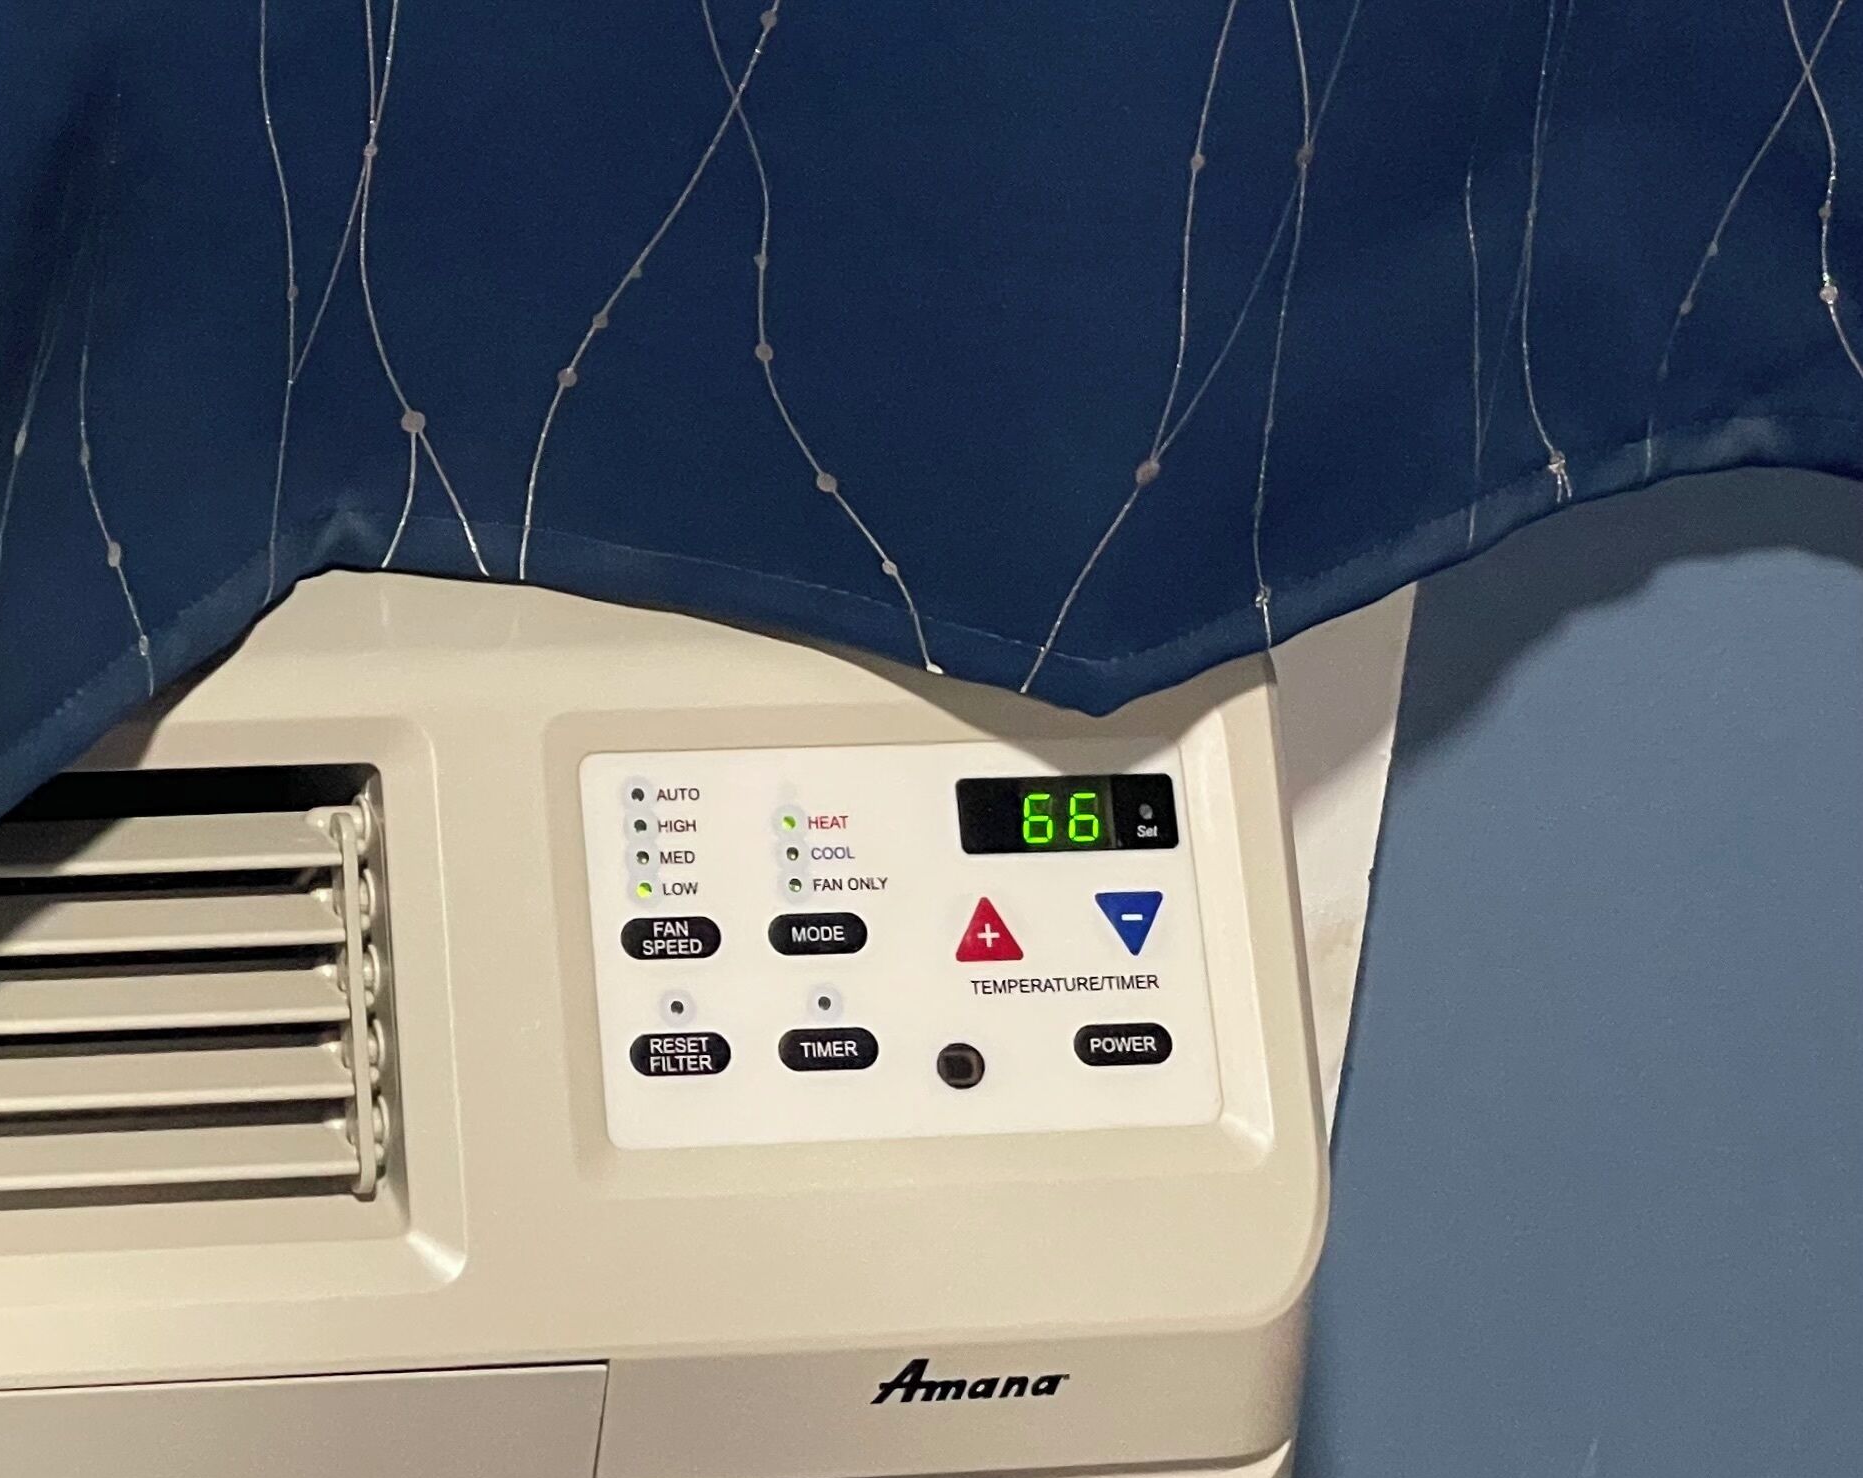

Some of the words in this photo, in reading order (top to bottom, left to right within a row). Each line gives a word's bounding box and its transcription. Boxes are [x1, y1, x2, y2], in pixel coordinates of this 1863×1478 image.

[656, 788, 700, 801] AUTO
[657, 819, 697, 833] HIGH
[808, 815, 849, 829] HEAT
[1022, 792, 1099, 844] 66
[1137, 825, 1158, 838] Set
[659, 850, 696, 864] MED
[811, 846, 855, 860] COOL
[662, 882, 699, 896] LOW
[813, 878, 843, 891] FAN
[847, 876, 888, 891] ONLY
[653, 921, 689, 937] FAN
[791, 926, 845, 943] MODE
[642, 939, 703, 956] SPEED
[970, 974, 1160, 995] TEMPERATURE/TIMER
[649, 1036, 710, 1054] RESET
[799, 1040, 858, 1058] TIMER
[1089, 1036, 1157, 1054] POWER
[649, 1055, 713, 1072] FILTER
[869, 1358, 1069, 1405] Amana
